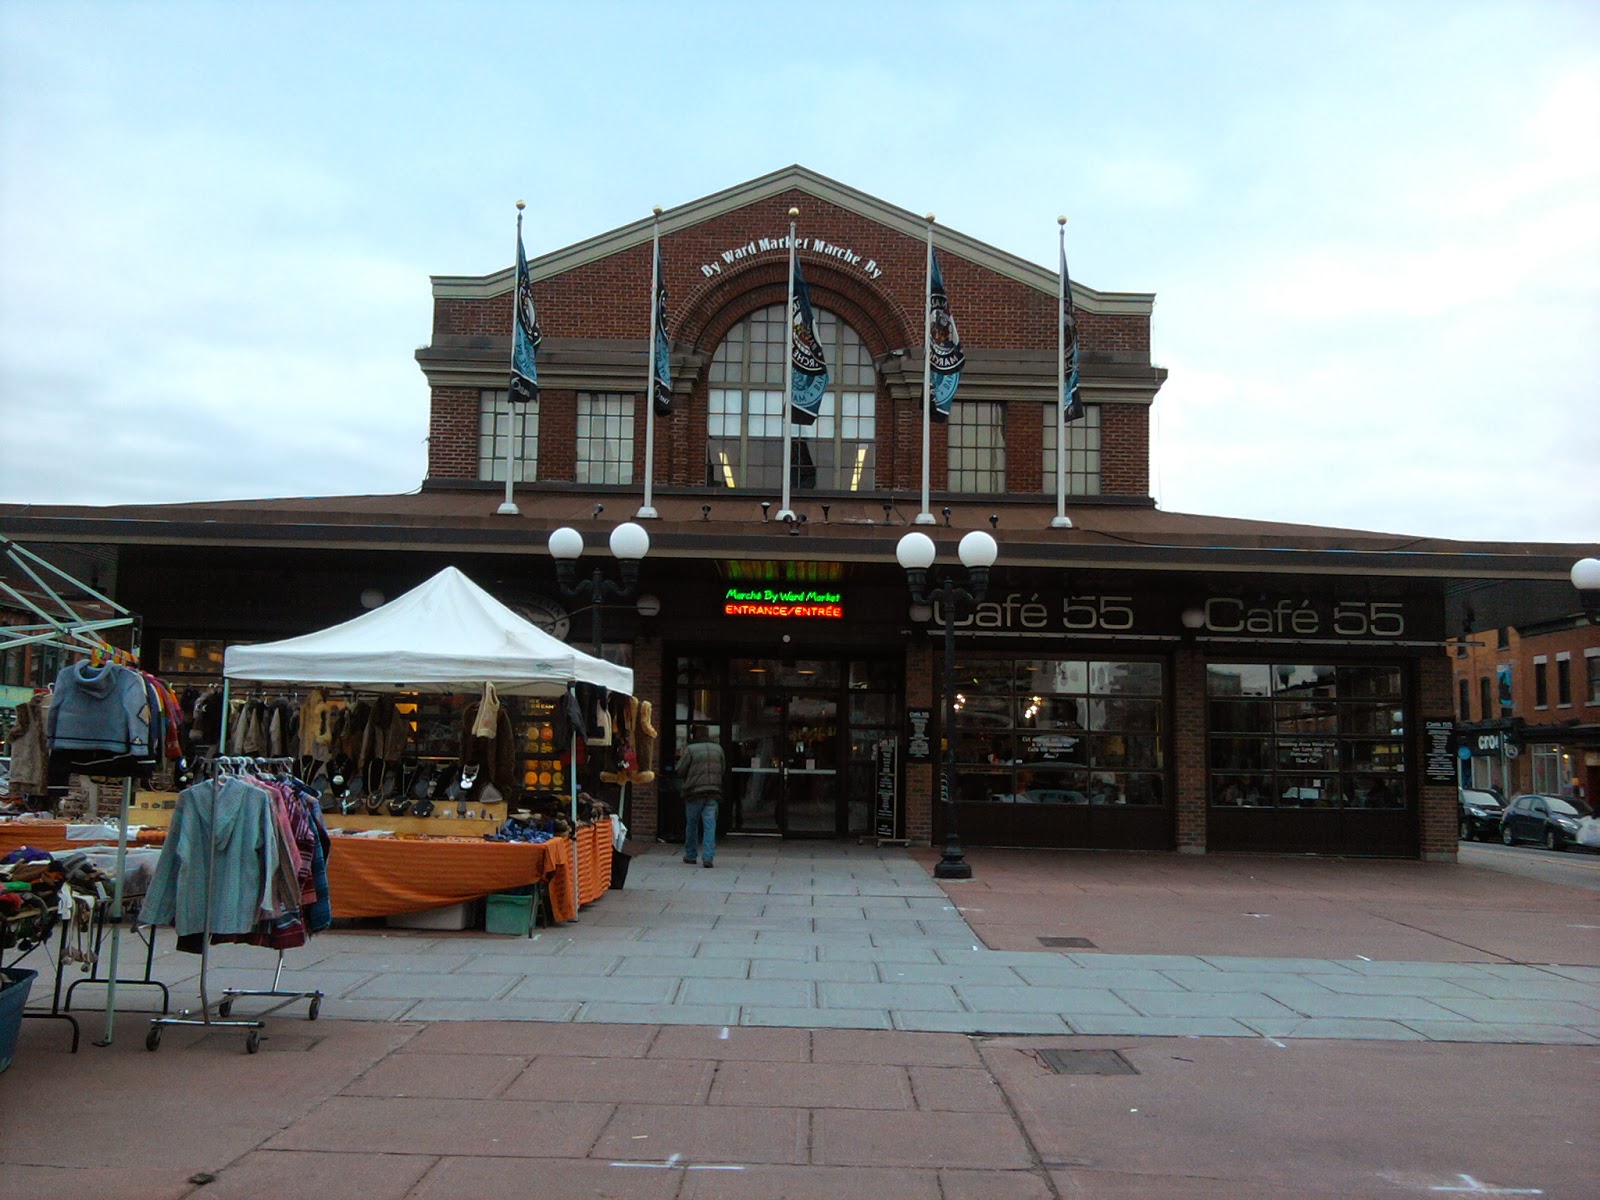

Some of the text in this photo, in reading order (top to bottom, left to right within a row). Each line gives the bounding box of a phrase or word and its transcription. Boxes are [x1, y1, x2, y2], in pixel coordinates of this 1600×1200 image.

[700, 260, 722, 278] By
[721, 242, 758, 266] Ward
[758, 235, 809, 252] Market
[864, 259, 882, 280] By
[764, 590, 778, 602] By
[780, 591, 805, 602] Ward
[806, 591, 841, 602] Market
[933, 593, 1134, 630] Café 55
[1204, 597, 1404, 636] Café 55
